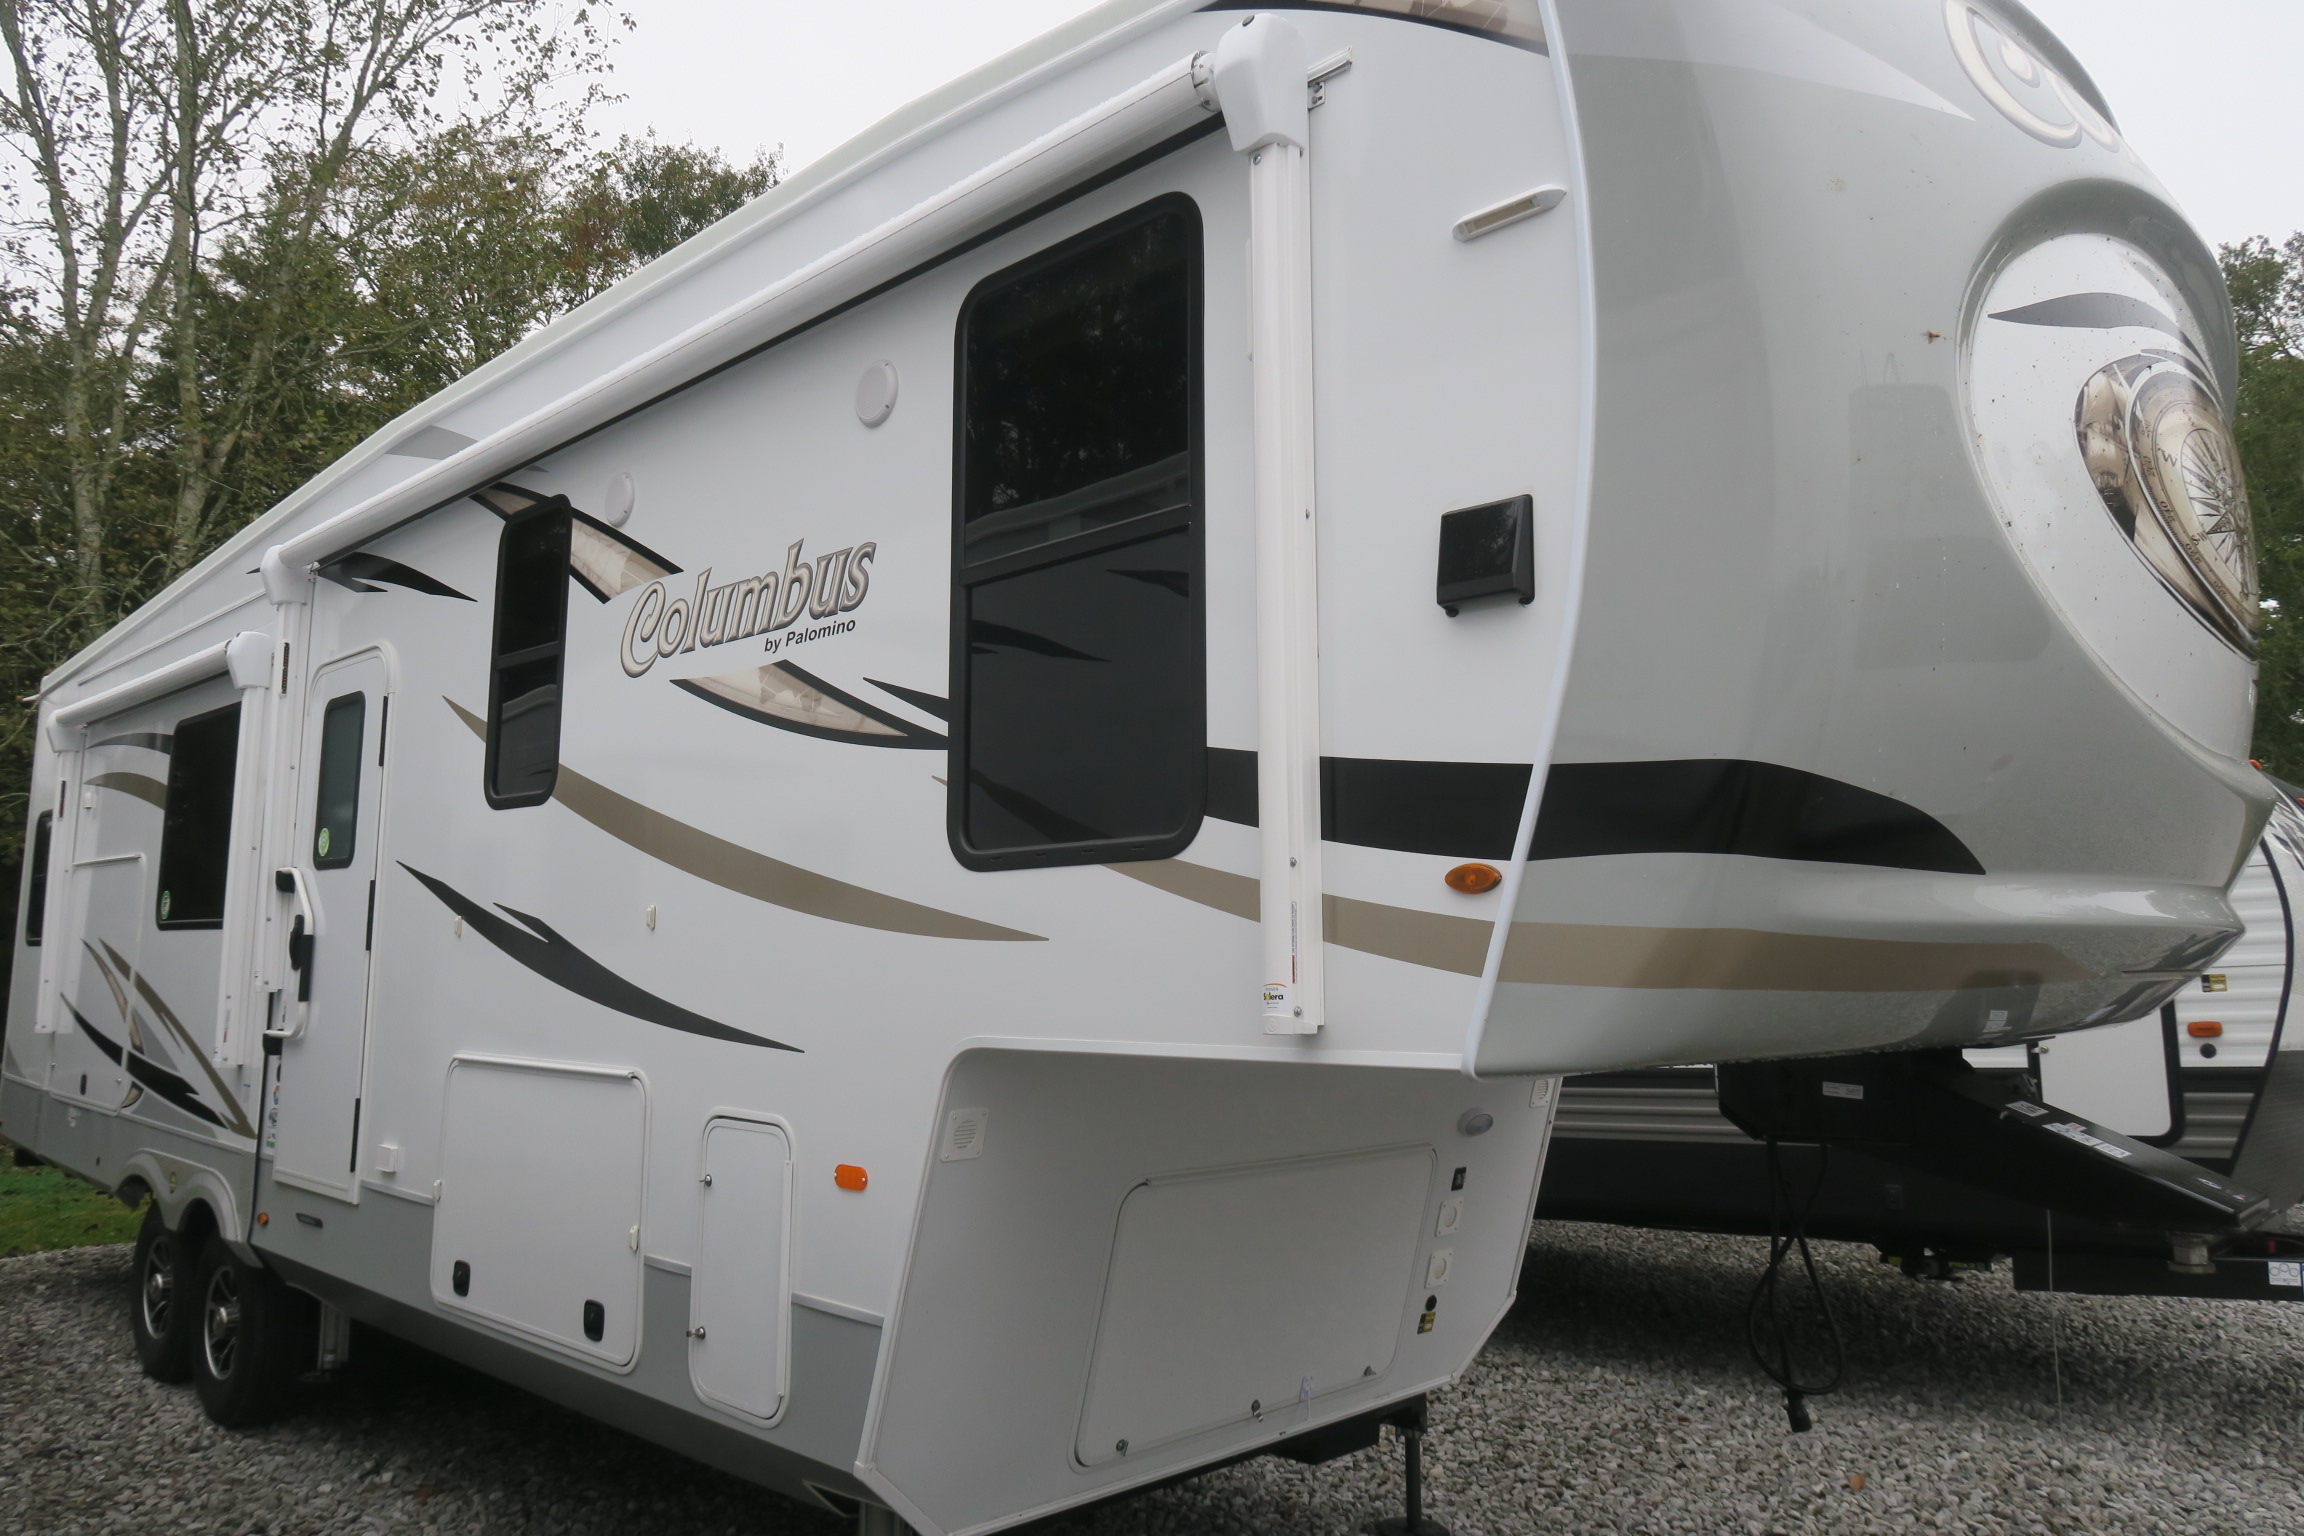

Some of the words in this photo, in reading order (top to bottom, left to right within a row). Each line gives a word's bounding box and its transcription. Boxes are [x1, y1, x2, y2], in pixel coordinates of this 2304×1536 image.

[620, 538, 877, 678] Columbus
[764, 637, 782, 654] by
[785, 619, 856, 647] Palomino
